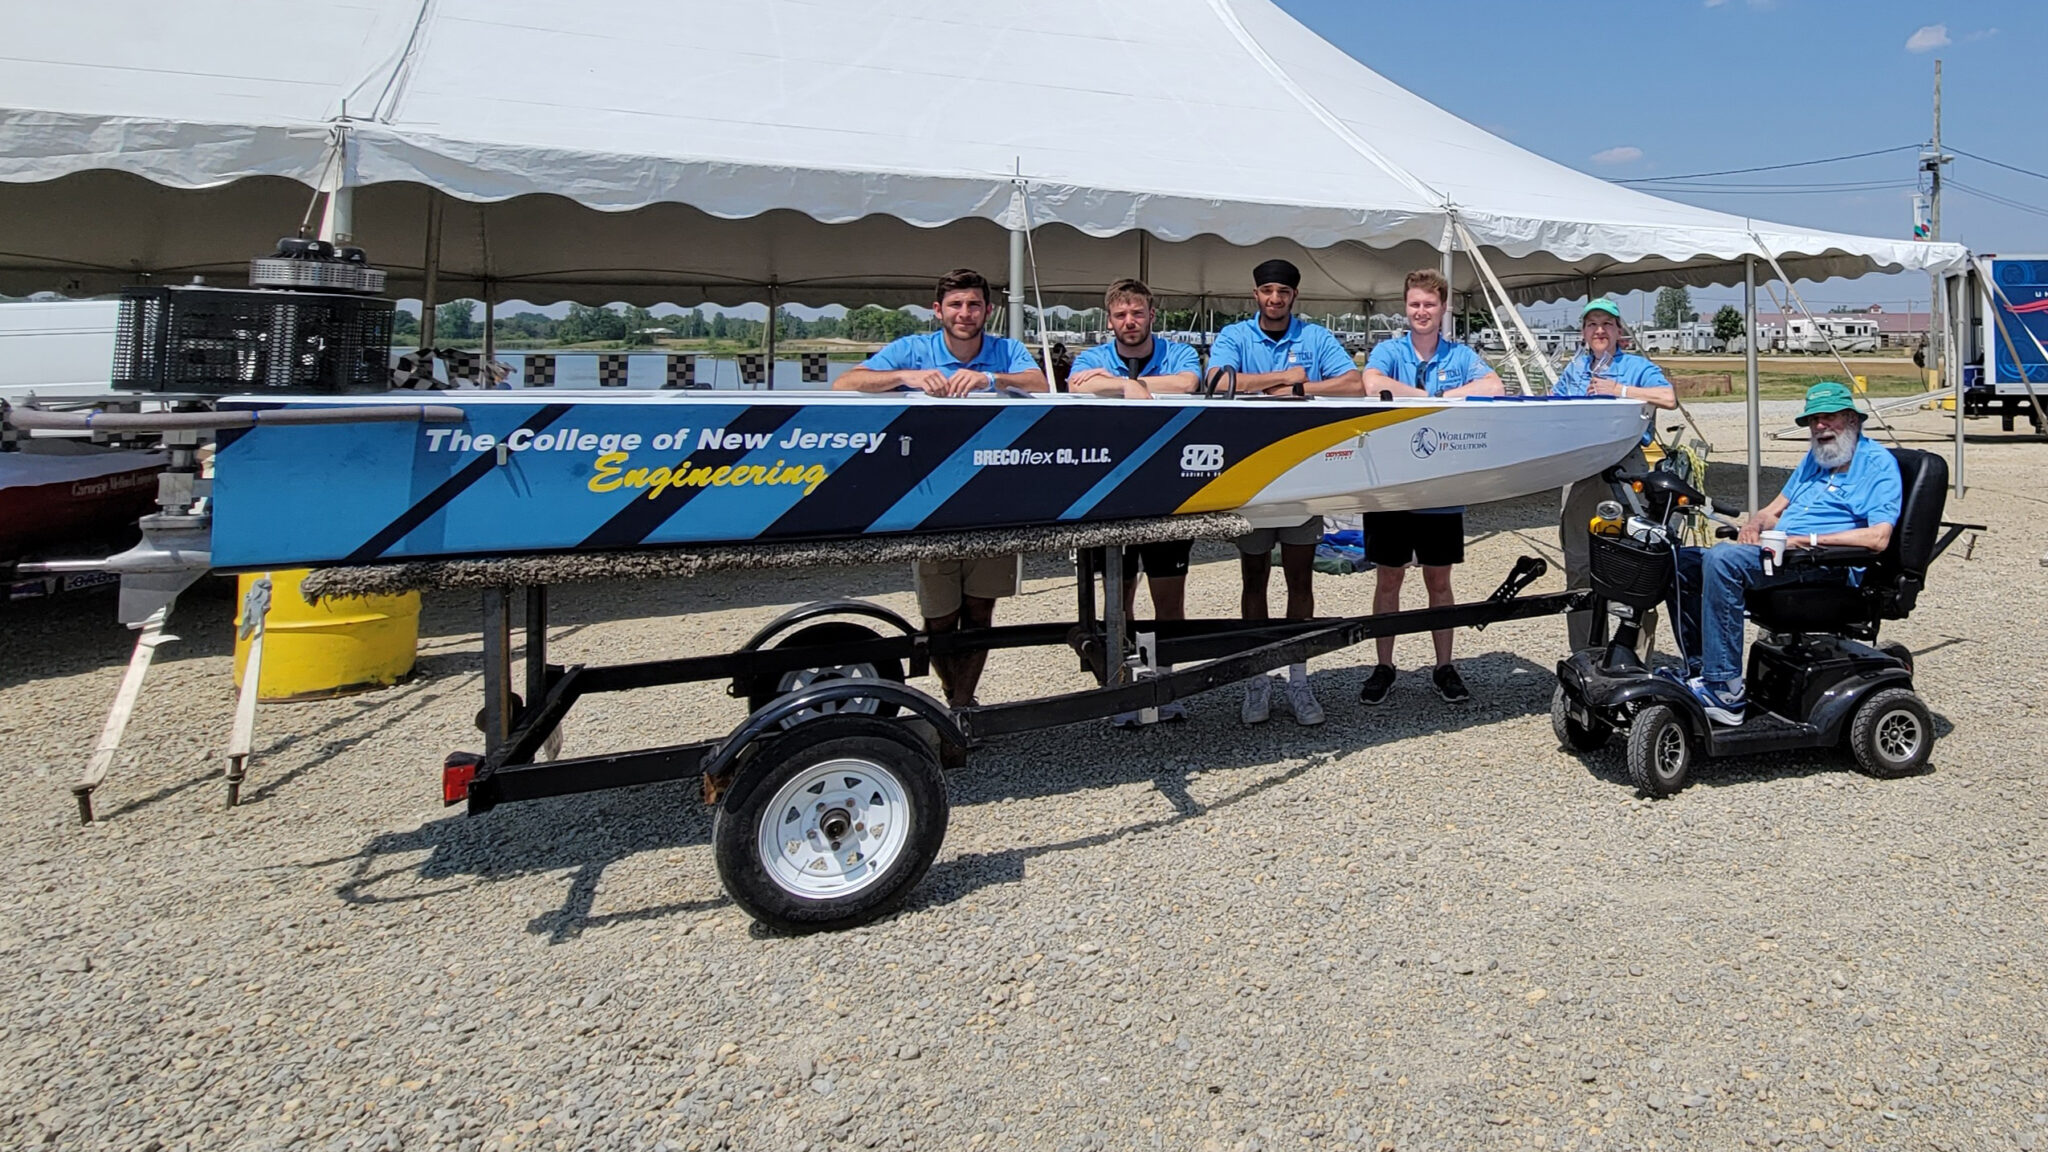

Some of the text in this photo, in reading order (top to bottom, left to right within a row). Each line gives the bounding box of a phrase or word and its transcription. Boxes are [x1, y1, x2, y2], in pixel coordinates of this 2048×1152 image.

[425, 428, 887, 456] The College of New Jersey
[1438, 431, 1488, 441] WORLDWIDE
[1439, 441, 1488, 451] IP SOLUTIONS
[973, 447, 1112, 466] BRECOflex CO., L.L.C.
[587, 451, 830, 500] Engineering
